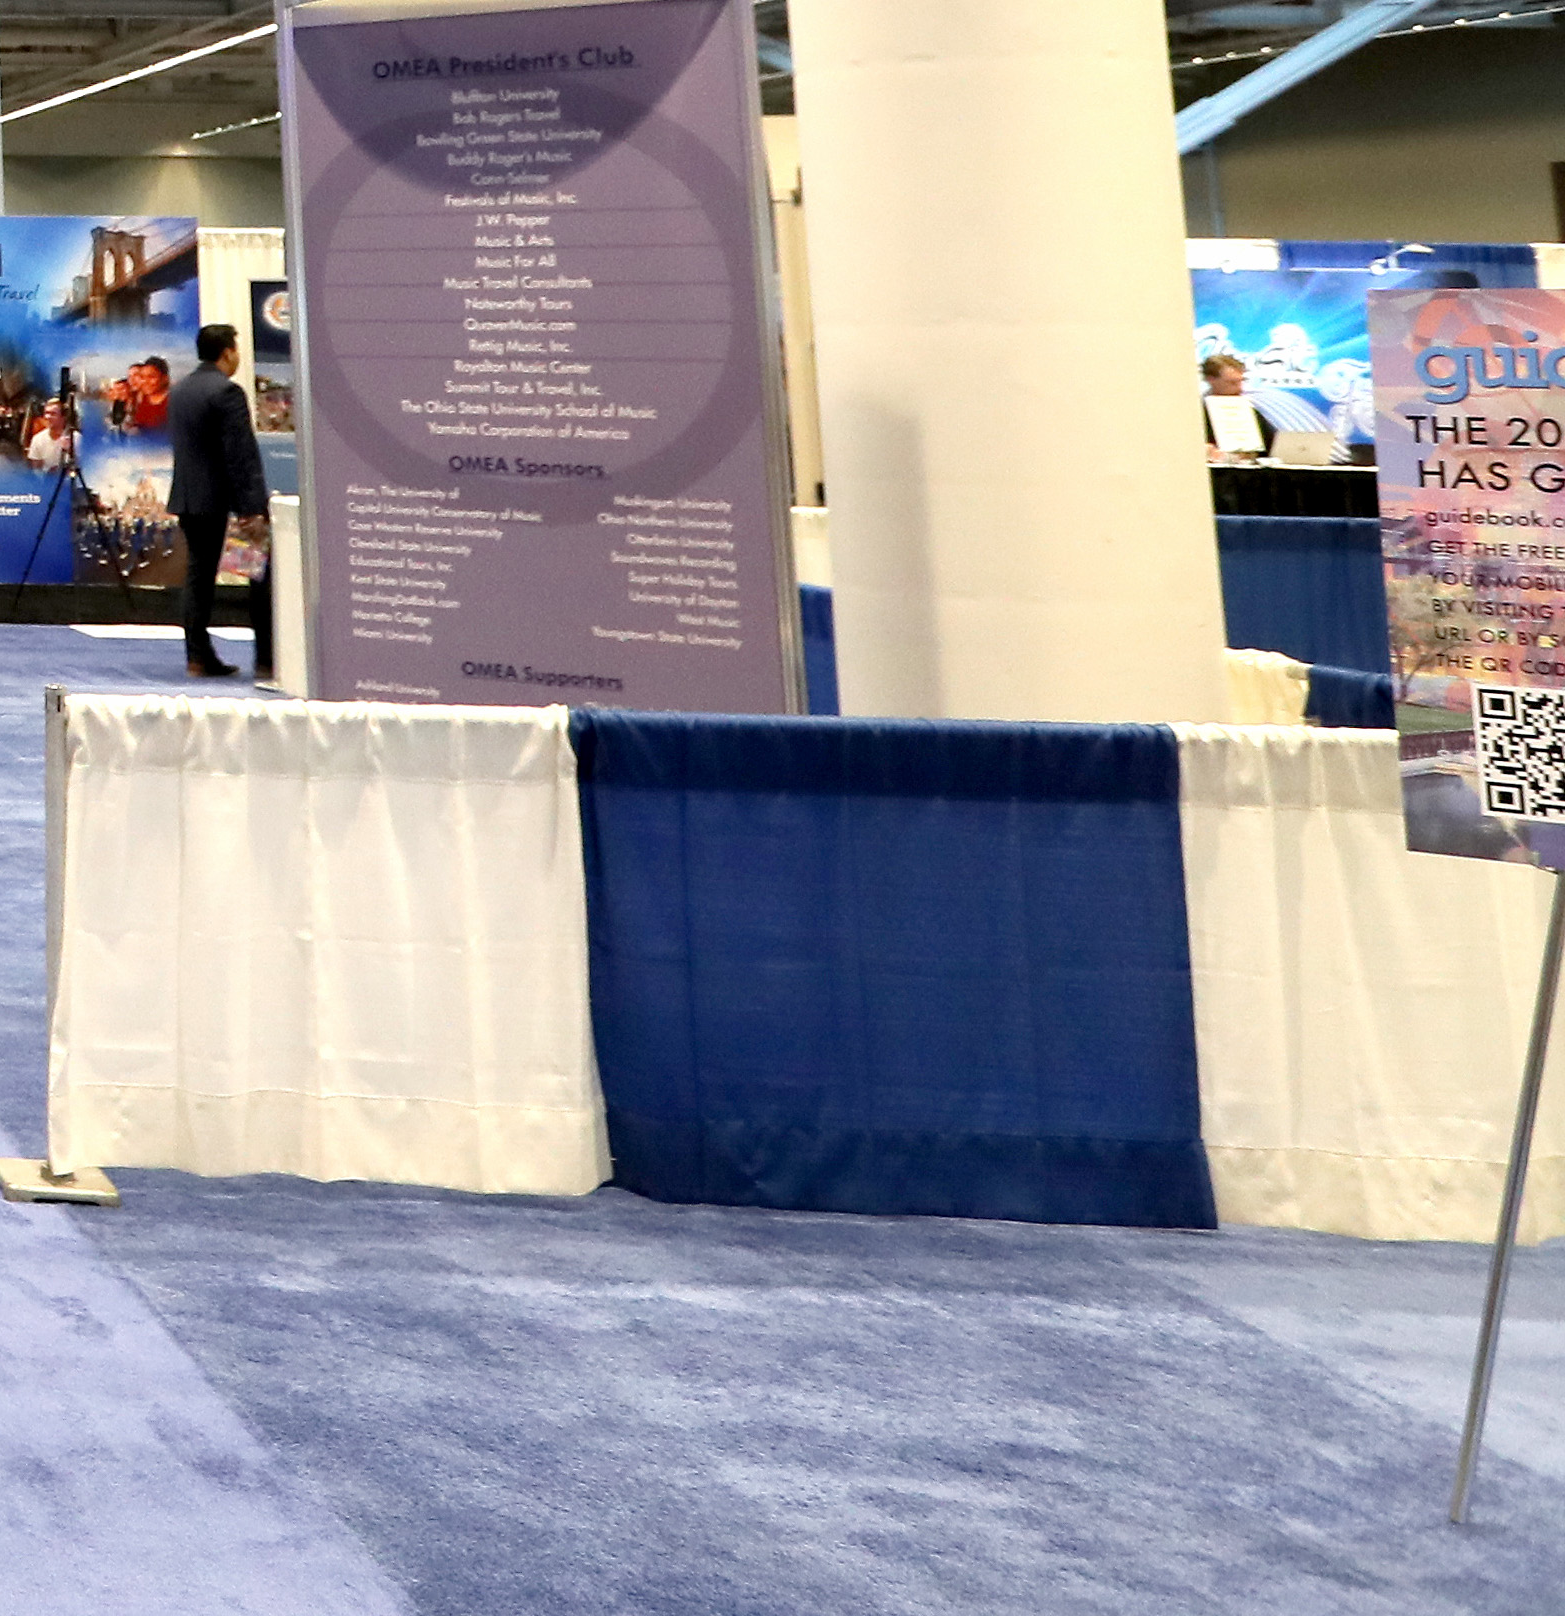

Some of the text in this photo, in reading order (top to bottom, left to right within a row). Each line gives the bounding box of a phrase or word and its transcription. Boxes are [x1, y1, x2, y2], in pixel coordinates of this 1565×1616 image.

[373, 46, 634, 79] OMEA President's Club
[1406, 415, 1488, 445] THE
[449, 456, 605, 477] OMEA Sponsors
[1419, 459, 1510, 491] HAS
[1429, 540, 1565, 560] GET THE FREE
[1433, 598, 1554, 618] BY VISITING
[1435, 626, 1471, 641] URL
[1479, 629, 1508, 643] OR
[1437, 654, 1473, 669] THE
[1481, 657, 1511, 672] QR
[461, 661, 623, 691] OMEA Supporters
